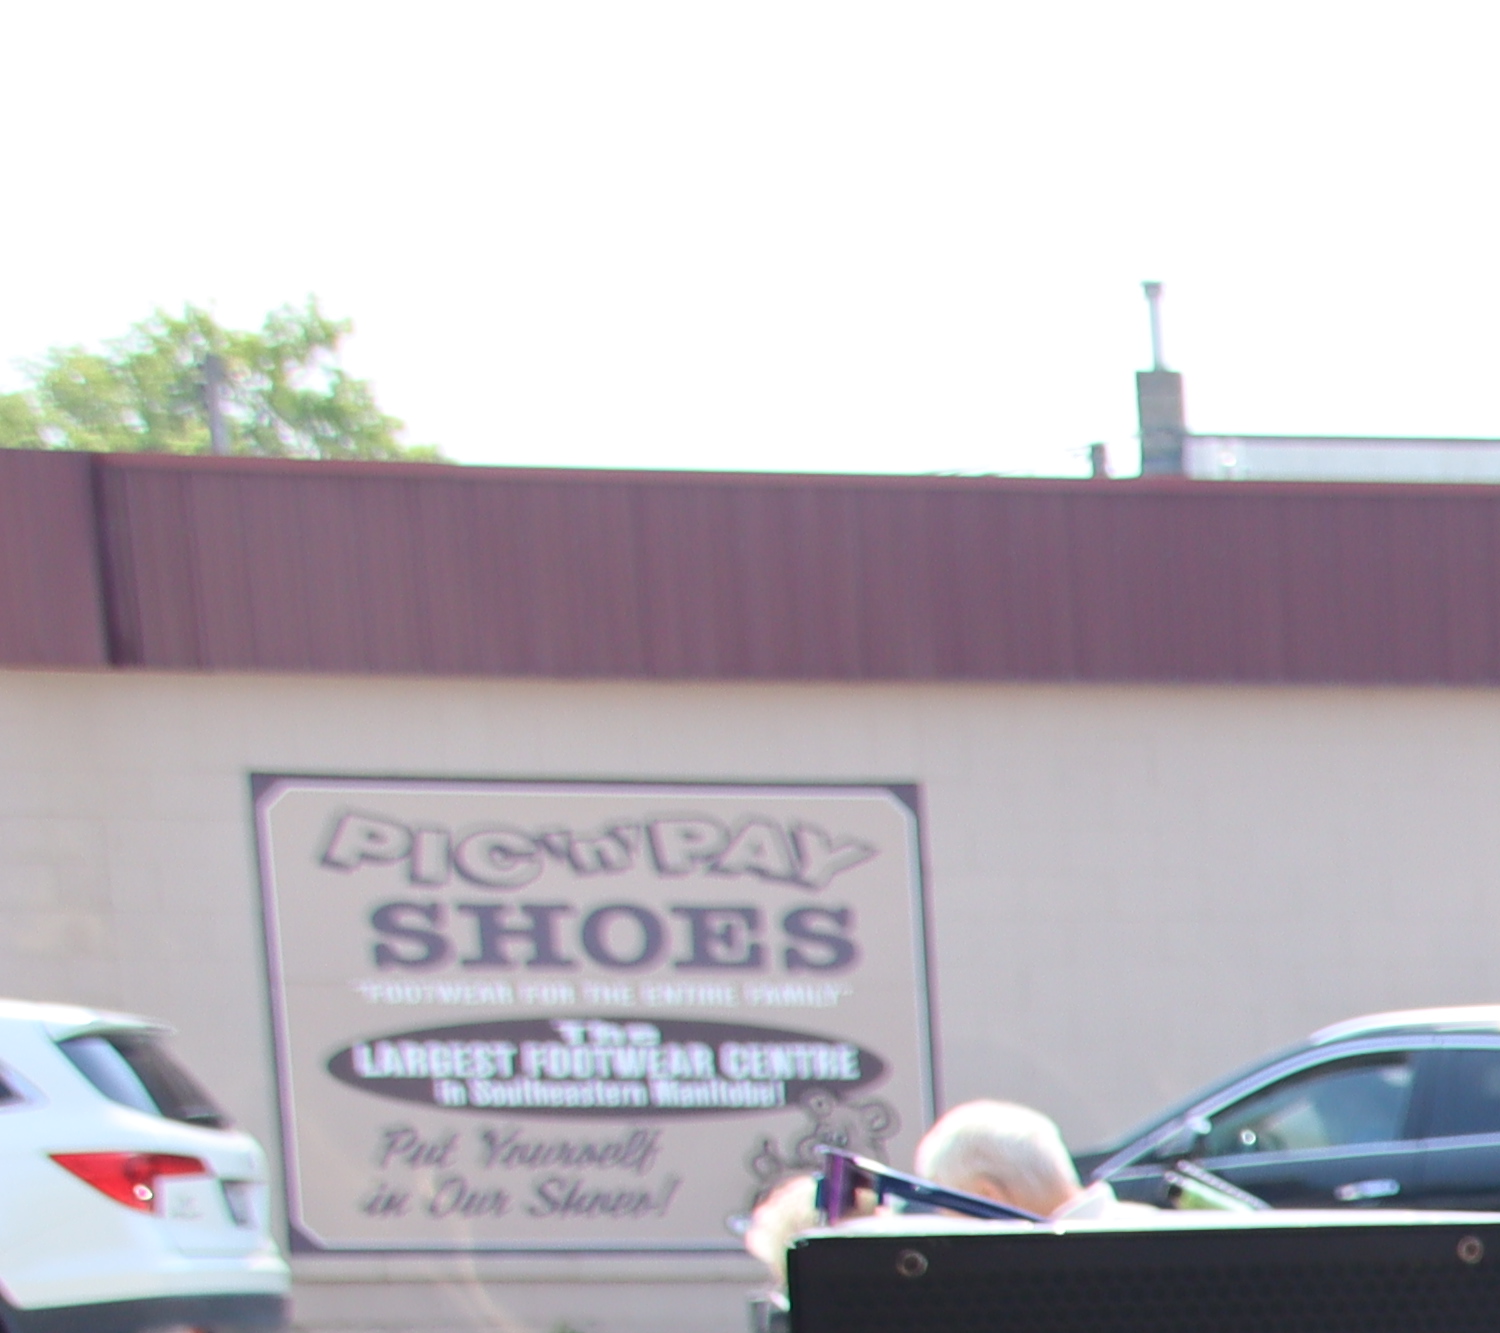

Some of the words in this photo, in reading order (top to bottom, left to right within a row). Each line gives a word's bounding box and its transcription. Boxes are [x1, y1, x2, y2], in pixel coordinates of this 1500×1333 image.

[368, 900, 860, 974] SHOES
[552, 1019, 662, 1047] The
[352, 1042, 518, 1078] LARGEST
[520, 1043, 714, 1079] FOOTWEAR
[720, 1044, 863, 1080] CENTRE
[434, 1079, 467, 1106] in
[469, 1080, 648, 1108] Southeastern
